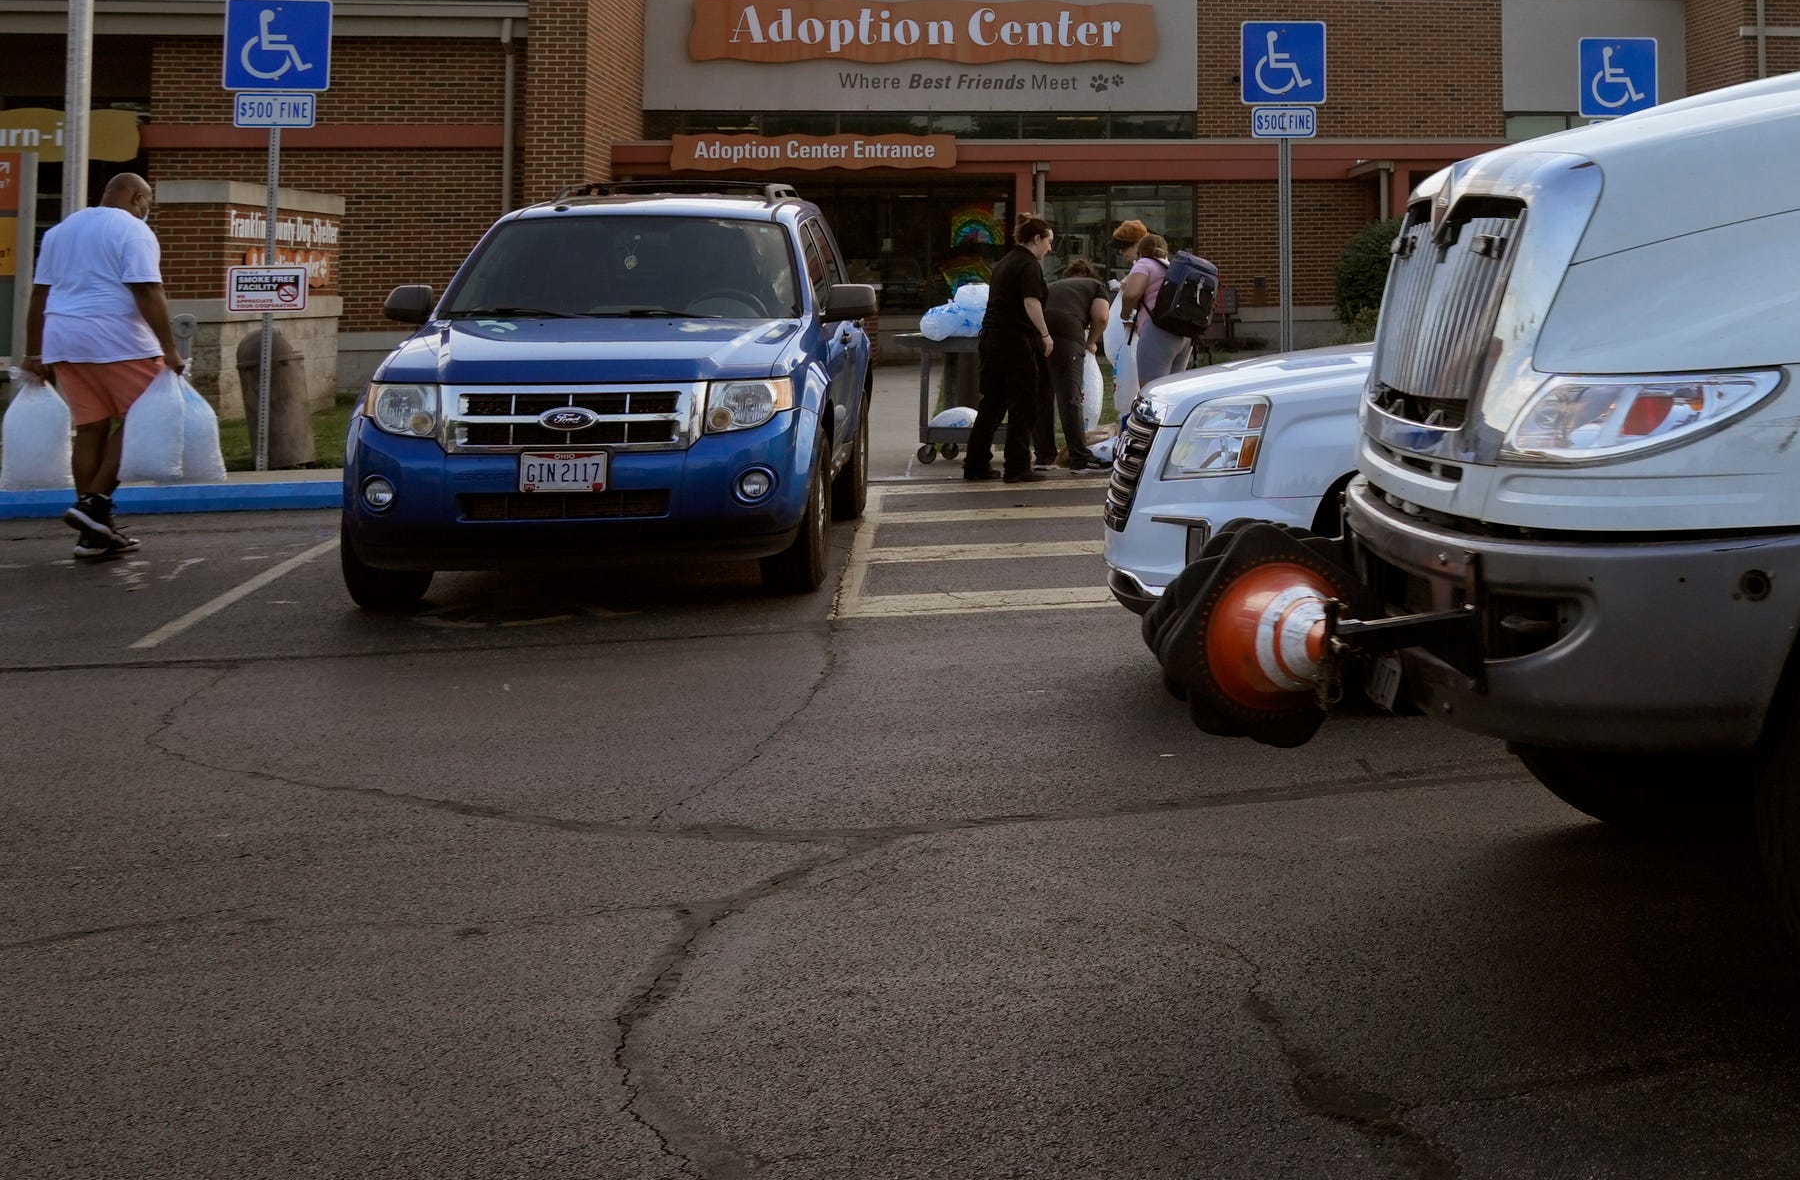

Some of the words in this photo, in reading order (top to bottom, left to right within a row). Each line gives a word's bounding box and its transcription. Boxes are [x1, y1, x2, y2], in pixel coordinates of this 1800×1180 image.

[729, 4, 955, 53] Adoption
[968, 7, 1121, 47] Center
[839, 72, 901, 90] Where
[908, 73, 952, 90] Best
[957, 73, 1026, 91] Friends
[1031, 74, 1078, 90] Meet
[240, 102, 273, 118] $500
[280, 102, 308, 118] FINE
[1257, 114, 1285, 130] $500
[1289, 114, 1312, 130] FINE
[694, 140, 781, 163] Adoption
[786, 140, 848, 159] Center
[853, 140, 935, 158] Entrance
[296, 216, 312, 249] Dog
[553, 413, 582, 424] Ford
[527, 463, 556, 482] GIN
[561, 463, 600, 482] 2117
